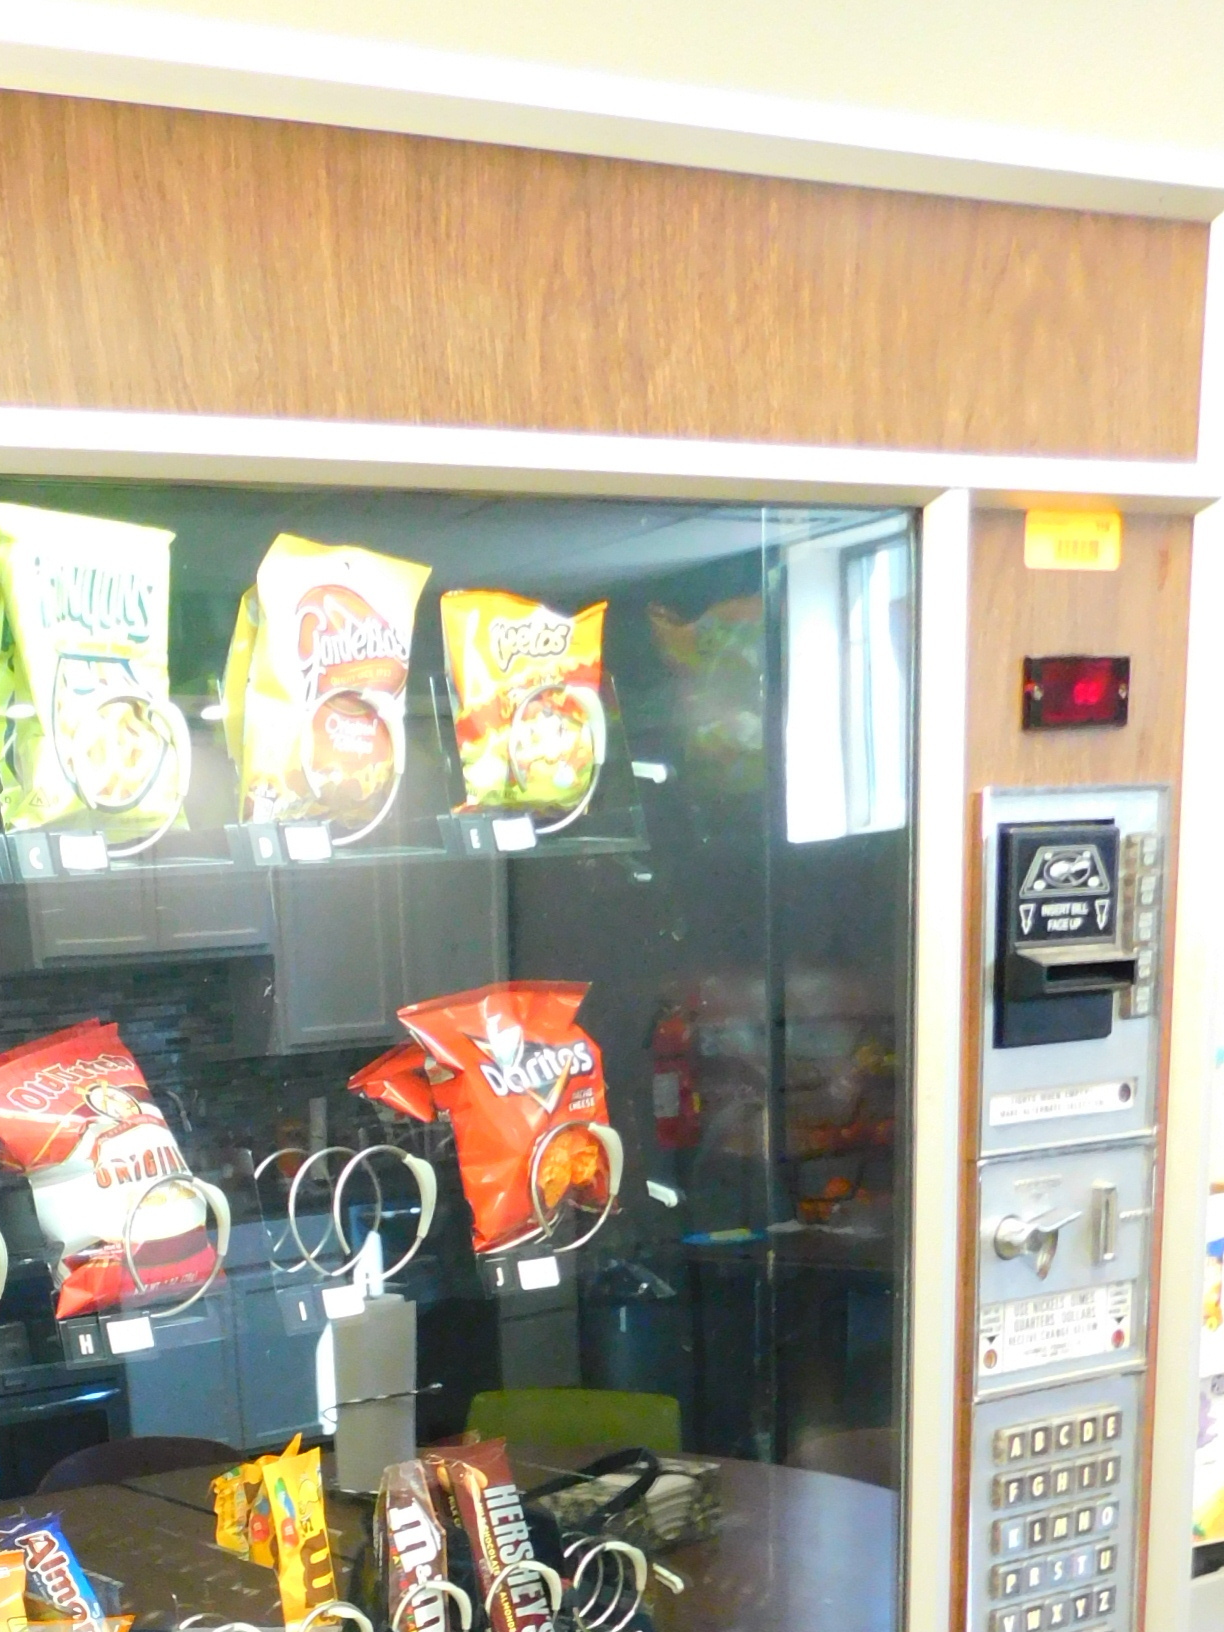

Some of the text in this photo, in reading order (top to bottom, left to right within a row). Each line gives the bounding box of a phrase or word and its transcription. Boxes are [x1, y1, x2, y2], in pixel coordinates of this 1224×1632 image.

[1047, 917, 1083, 932] FACE UP
[479, 1040, 593, 1097] Doritos
[569, 1097, 595, 1112] CHEESE
[495, 1267, 504, 1287] J
[78, 1332, 93, 1356] H
[1011, 1437, 1021, 1458] A
[1060, 1425, 1069, 1446] C
[1083, 1421, 1093, 1442] D
[1107, 1416, 1115, 1437] E
[1009, 1482, 1018, 1503] F
[1032, 1475, 1044, 1497] G
[1057, 1471, 1068, 1493] H
[1105, 1461, 1114, 1482] J
[1034, 1522, 1041, 1542] L
[1101, 1506, 1114, 1526] O
[1006, 1550, 1111, 1594] P R S T U
[1027, 1609, 1041, 1631] W
[1051, 1603, 1063, 1624] X
[1076, 1598, 1086, 1618] Y
[1099, 1591, 1110, 1612] Z
